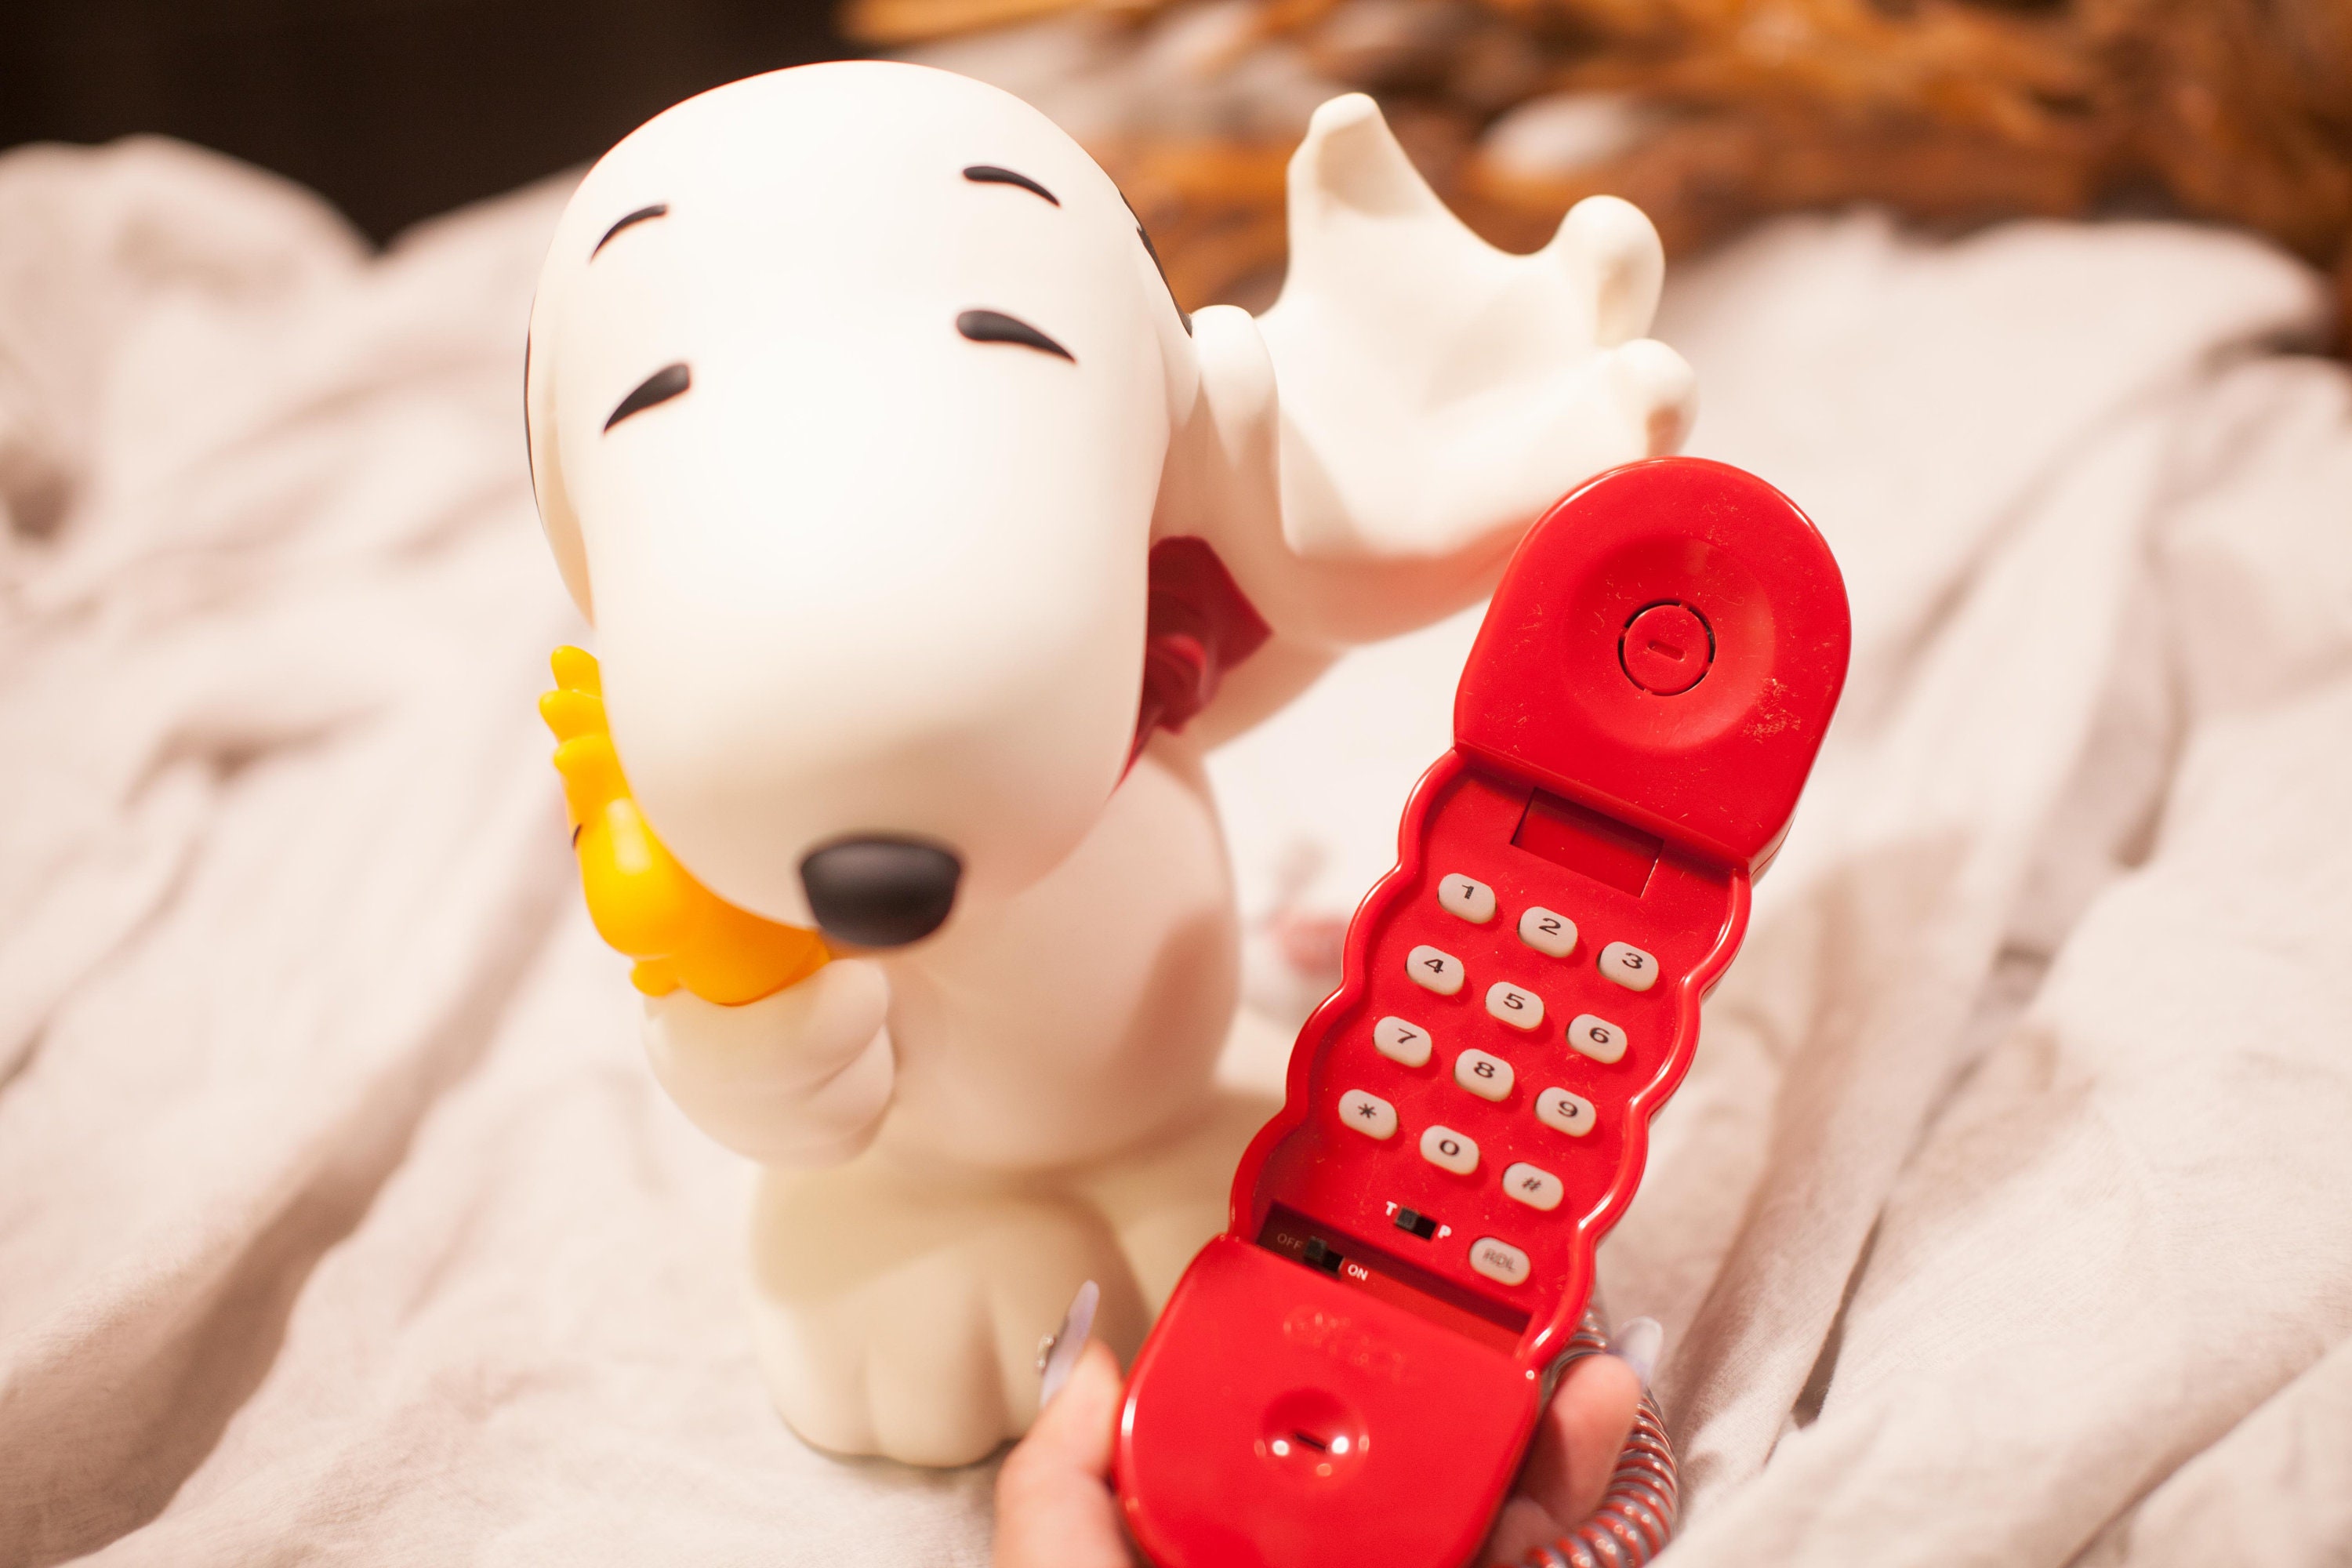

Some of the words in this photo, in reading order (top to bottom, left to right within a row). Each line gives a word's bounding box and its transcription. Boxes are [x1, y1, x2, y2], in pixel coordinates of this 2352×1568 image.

[1461, 884, 1475, 900] 1
[1538, 917, 1561, 935] 2
[1622, 952, 1644, 969] 3
[1424, 958, 1444, 974] 4
[1504, 992, 1525, 1010] 5
[1590, 1027, 1610, 1044] 6
[1397, 1028, 1417, 1044] 7
[1474, 1062, 1495, 1079] 8
[1558, 1101, 1579, 1117] 9
[1439, 1139, 1460, 1156] 0
[1523, 1178, 1541, 1191] #
[1385, 1201, 1397, 1216] T
[1438, 1225, 1451, 1239] P
[1276, 1233, 1301, 1248] OFF
[1348, 1264, 1368, 1280] ON
